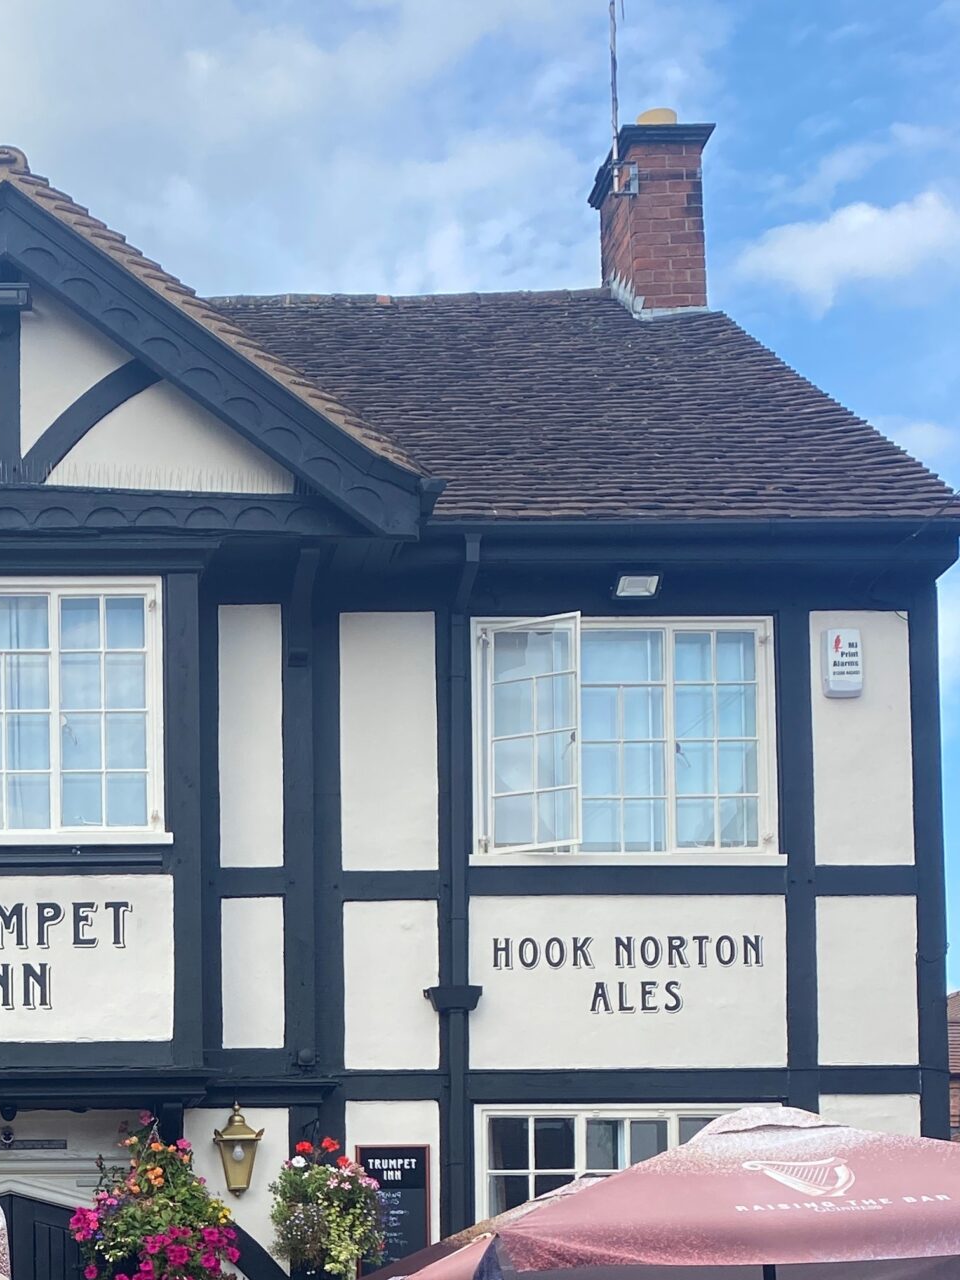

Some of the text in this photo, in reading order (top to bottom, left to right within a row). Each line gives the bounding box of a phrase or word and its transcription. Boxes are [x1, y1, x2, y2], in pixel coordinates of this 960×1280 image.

[492, 934, 764, 971] HOOK NORTON
[590, 981, 684, 1014] ALES
[368, 1159, 417, 1169] TRUMPET
[383, 1170, 402, 1180] INN
[735, 1193, 952, 1213] RAISING THE BAR
